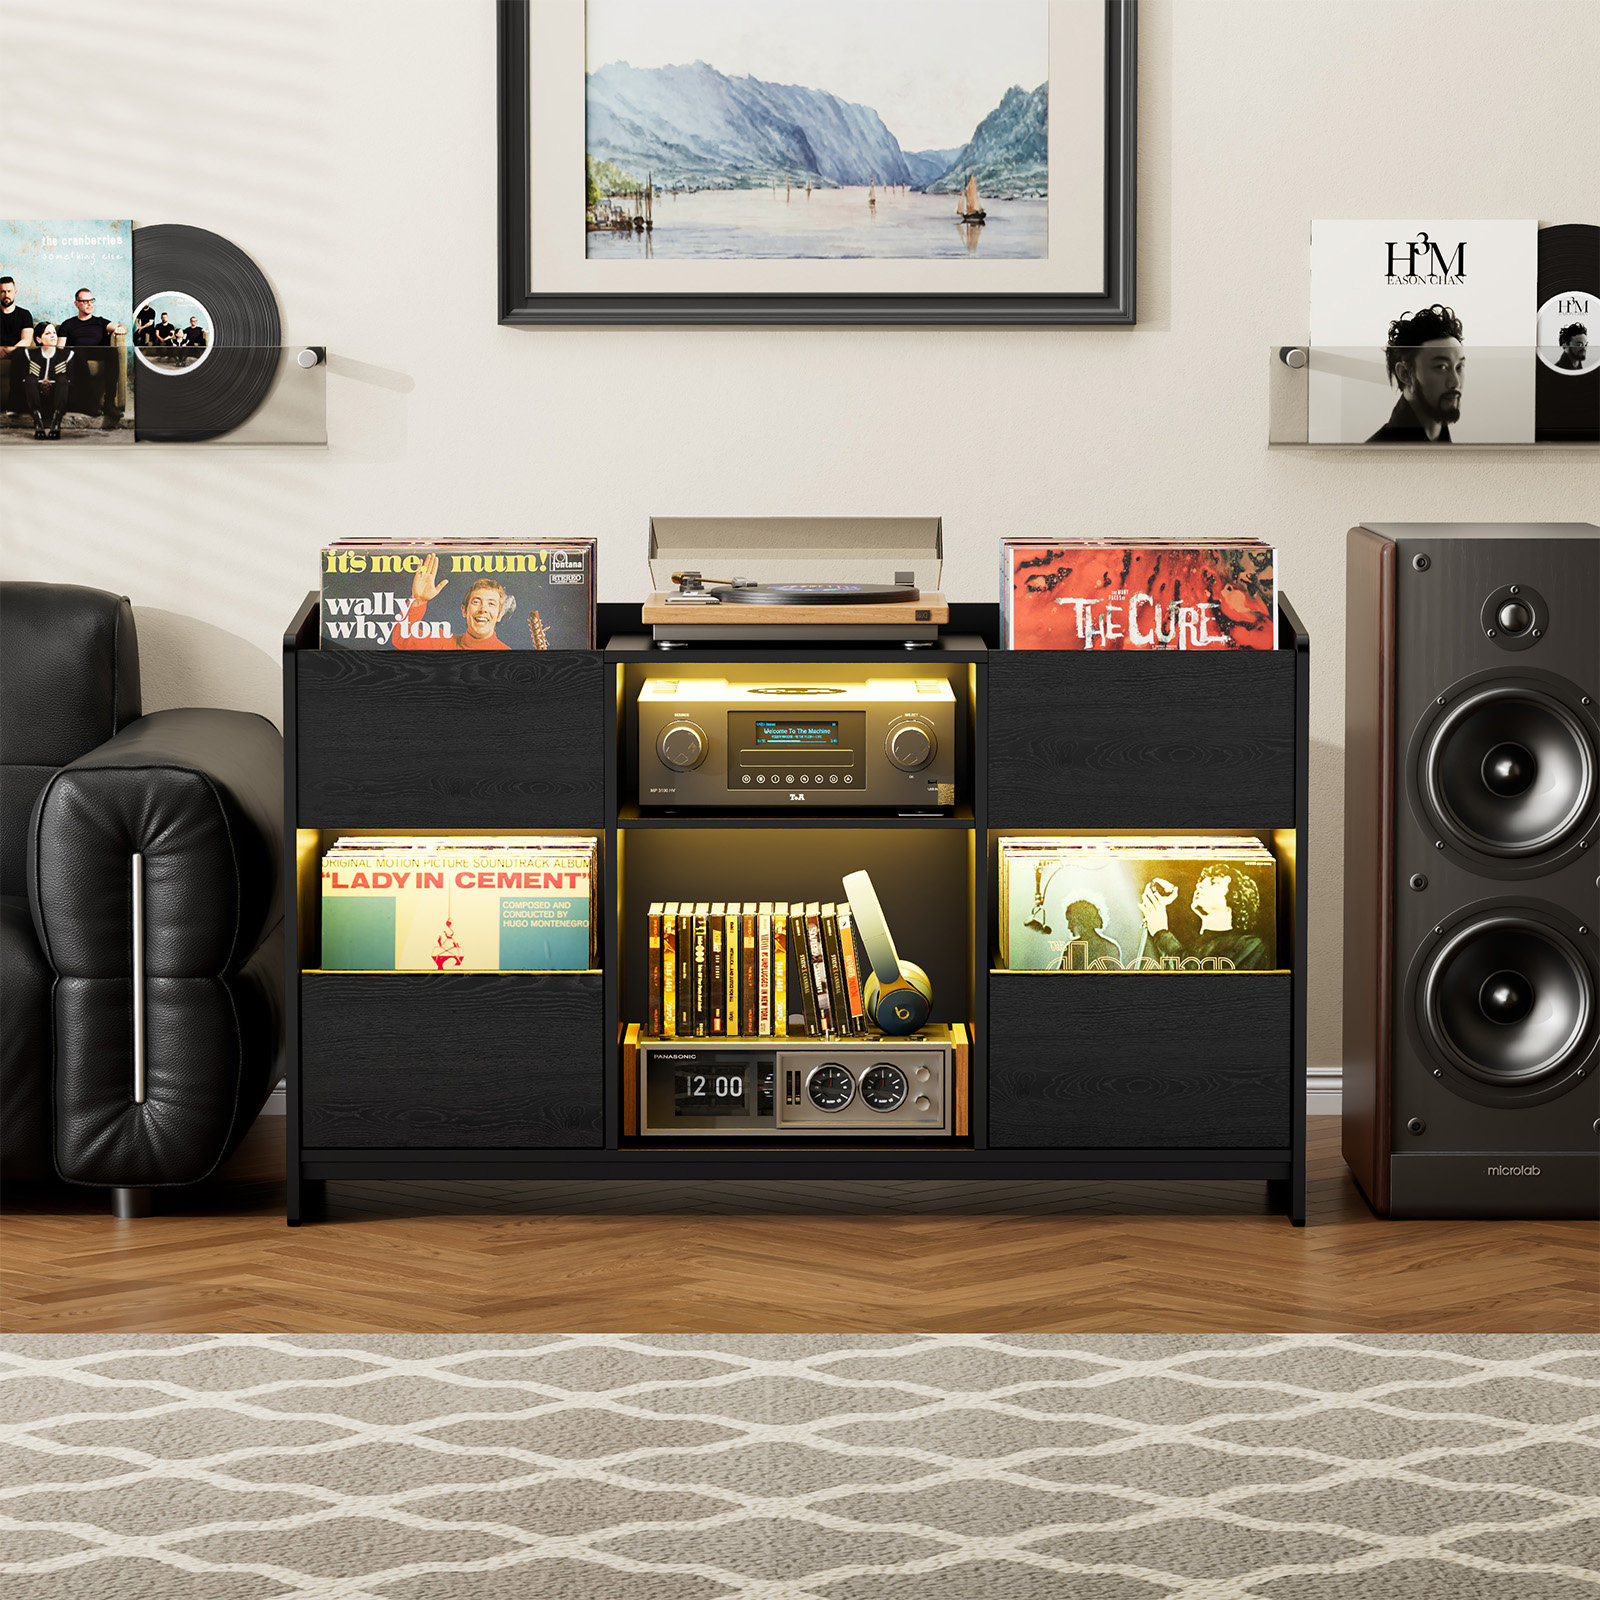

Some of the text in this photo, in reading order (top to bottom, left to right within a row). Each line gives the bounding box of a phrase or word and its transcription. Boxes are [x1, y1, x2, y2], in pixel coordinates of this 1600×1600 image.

[41, 234, 123, 246] the cranberries
[42, 250, 96, 266] something
[1387, 275, 1465, 286] EASON CHAN
[325, 550, 367, 574] it's
[450, 549, 548, 574] mum!
[552, 554, 583, 571] fontana
[325, 592, 416, 622] wally
[1128, 590, 1231, 650] CURE
[325, 615, 454, 645] whyton
[763, 727, 831, 735] Welcome To The Machine
[322, 858, 590, 869] ORIGINAL MOTION PICTURE SOUNDTRACK ALBUM
[416, 872, 444, 889] IN
[502, 901, 572, 910] COMPOSED AND
[502, 910, 569, 919] CONDUCTED BY
[503, 919, 590, 928] HUGO MONTENEGRO
[760, 957, 769, 988] UNPLUGGED
[760, 995, 769, 1007] NEW
[760, 1007, 769, 1021] YORK
[1487, 1164, 1541, 1176] microlab
